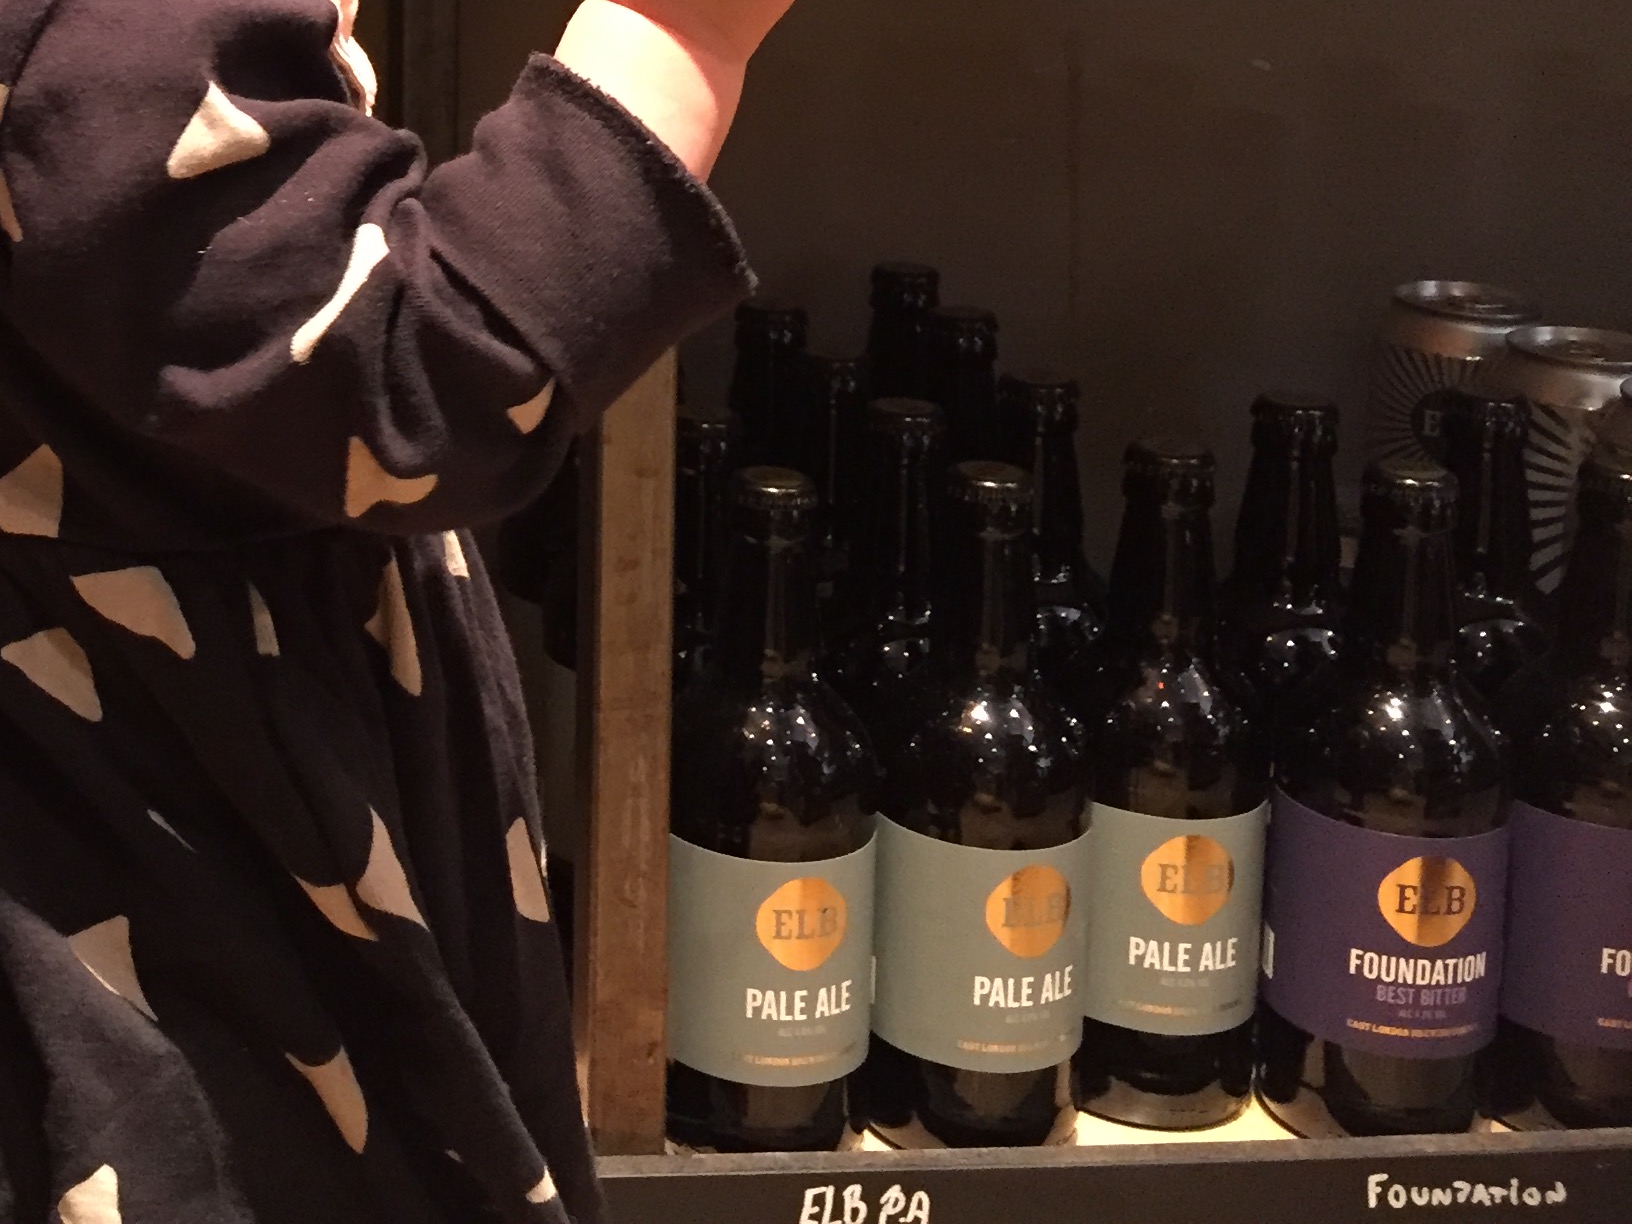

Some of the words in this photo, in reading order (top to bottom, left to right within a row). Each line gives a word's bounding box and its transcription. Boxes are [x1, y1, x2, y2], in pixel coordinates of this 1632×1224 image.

[1395, 884, 1467, 915] ELB
[773, 906, 839, 939] ELB
[1128, 936, 1192, 972] PALE
[1199, 937, 1238, 972] ALE
[1349, 948, 1487, 986] FOUNDATION
[745, 988, 808, 1021] PALE
[815, 979, 853, 1018] ALE
[973, 976, 1035, 1008] PALE
[1040, 964, 1073, 1005] ALE
[1376, 984, 1416, 1005] BEST
[1420, 986, 1467, 1006] BITTER
[799, 1183, 868, 1224] ELB
